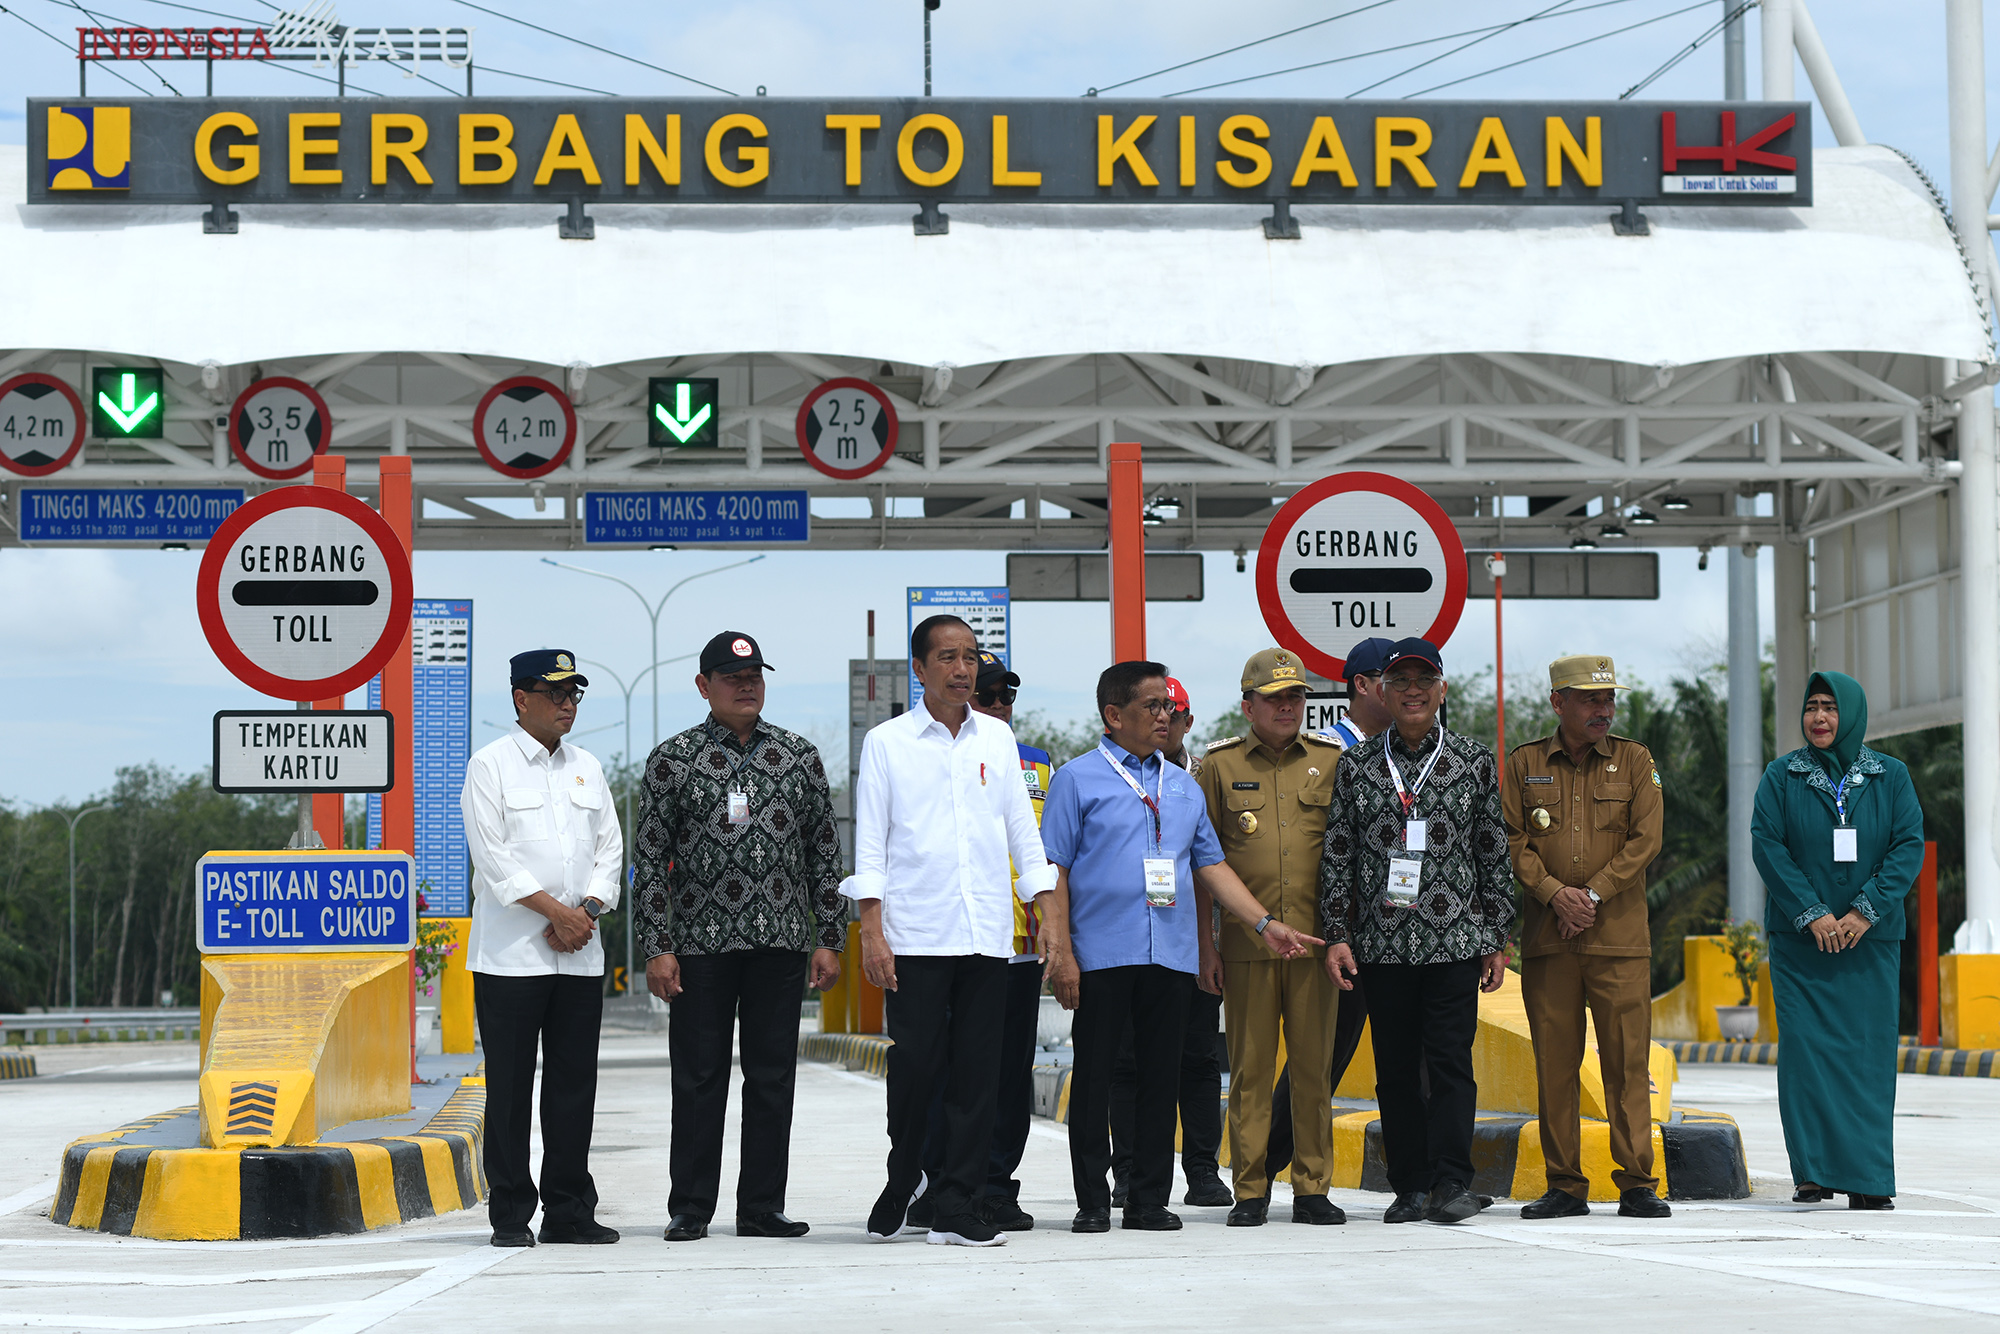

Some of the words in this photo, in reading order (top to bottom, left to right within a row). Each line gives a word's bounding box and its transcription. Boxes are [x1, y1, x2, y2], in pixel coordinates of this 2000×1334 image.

[312, 26, 477, 79] MAJU
[194, 111, 770, 188] GERBANG
[825, 112, 1042, 188] TOL
[1097, 114, 1603, 189] KISARAN
[1682, 177, 1716, 190] Inovasi
[1719, 177, 1749, 190] Untuk
[1750, 177, 1778, 190] Solusi
[4, 416, 36, 441] 4,2
[43, 418, 63, 438] m
[258, 406, 301, 437] 3,5
[828, 399, 865, 433] 2,5
[496, 417, 531, 444] 4,2
[539, 419, 556, 438] m
[268, 439, 288, 462] m
[837, 436, 857, 460] m
[32, 495, 89, 519] TINGGI
[98, 494, 146, 519] MAKS
[596, 497, 651, 522] TINGGI
[659, 496, 707, 520] MAKS
[30, 525, 42, 535] PP
[108, 525, 127, 536] 2012
[135, 524, 159, 537] pasal
[167, 525, 178, 535] 54
[184, 524, 202, 537] ayat
[595, 527, 607, 537] PP
[669, 527, 689, 537] 2012
[696, 526, 720, 538] pasal
[730, 526, 740, 536] 54
[745, 526, 764, 538] ayat
[1296, 530, 1418, 558] GERBANG
[241, 545, 365, 573] GERBANG
[1332, 601, 1396, 628] TOLL
[273, 615, 332, 643] TOLL
[239, 723, 367, 749] TEMPELKAN
[264, 755, 340, 780] KARTU
[206, 870, 319, 902] PASTIKAN
[328, 869, 406, 900] SALDO
[217, 908, 303, 939] E-TOLL
[320, 906, 396, 937] CUKUP
